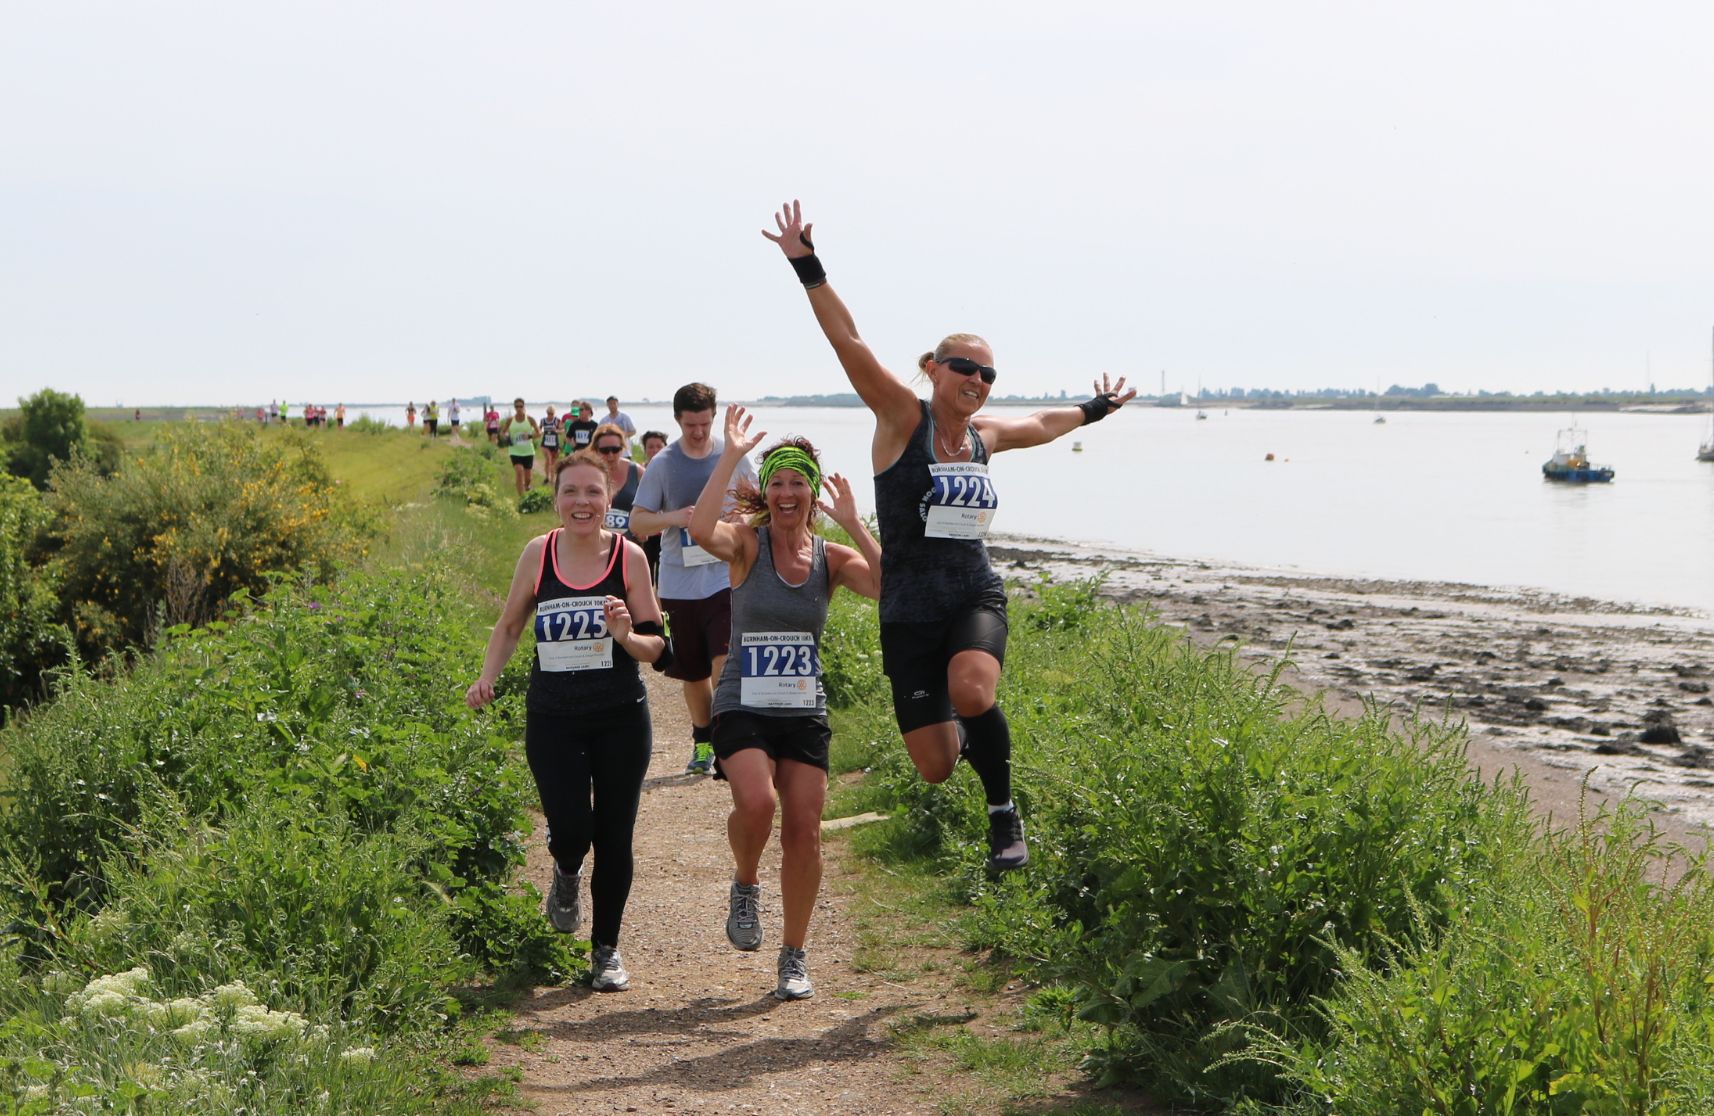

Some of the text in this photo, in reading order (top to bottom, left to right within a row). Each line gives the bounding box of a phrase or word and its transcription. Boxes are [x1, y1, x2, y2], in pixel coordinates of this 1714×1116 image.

[939, 476, 995, 508] 1224
[961, 512, 977, 520] Rotary
[539, 600, 593, 613] BURNHAM-ON-CROUCH
[542, 611, 608, 641] 1225
[743, 635, 800, 643] BURNHAM-ON-CROUCH
[748, 645, 812, 676] 1223
[778, 681, 796, 689] Rotary
